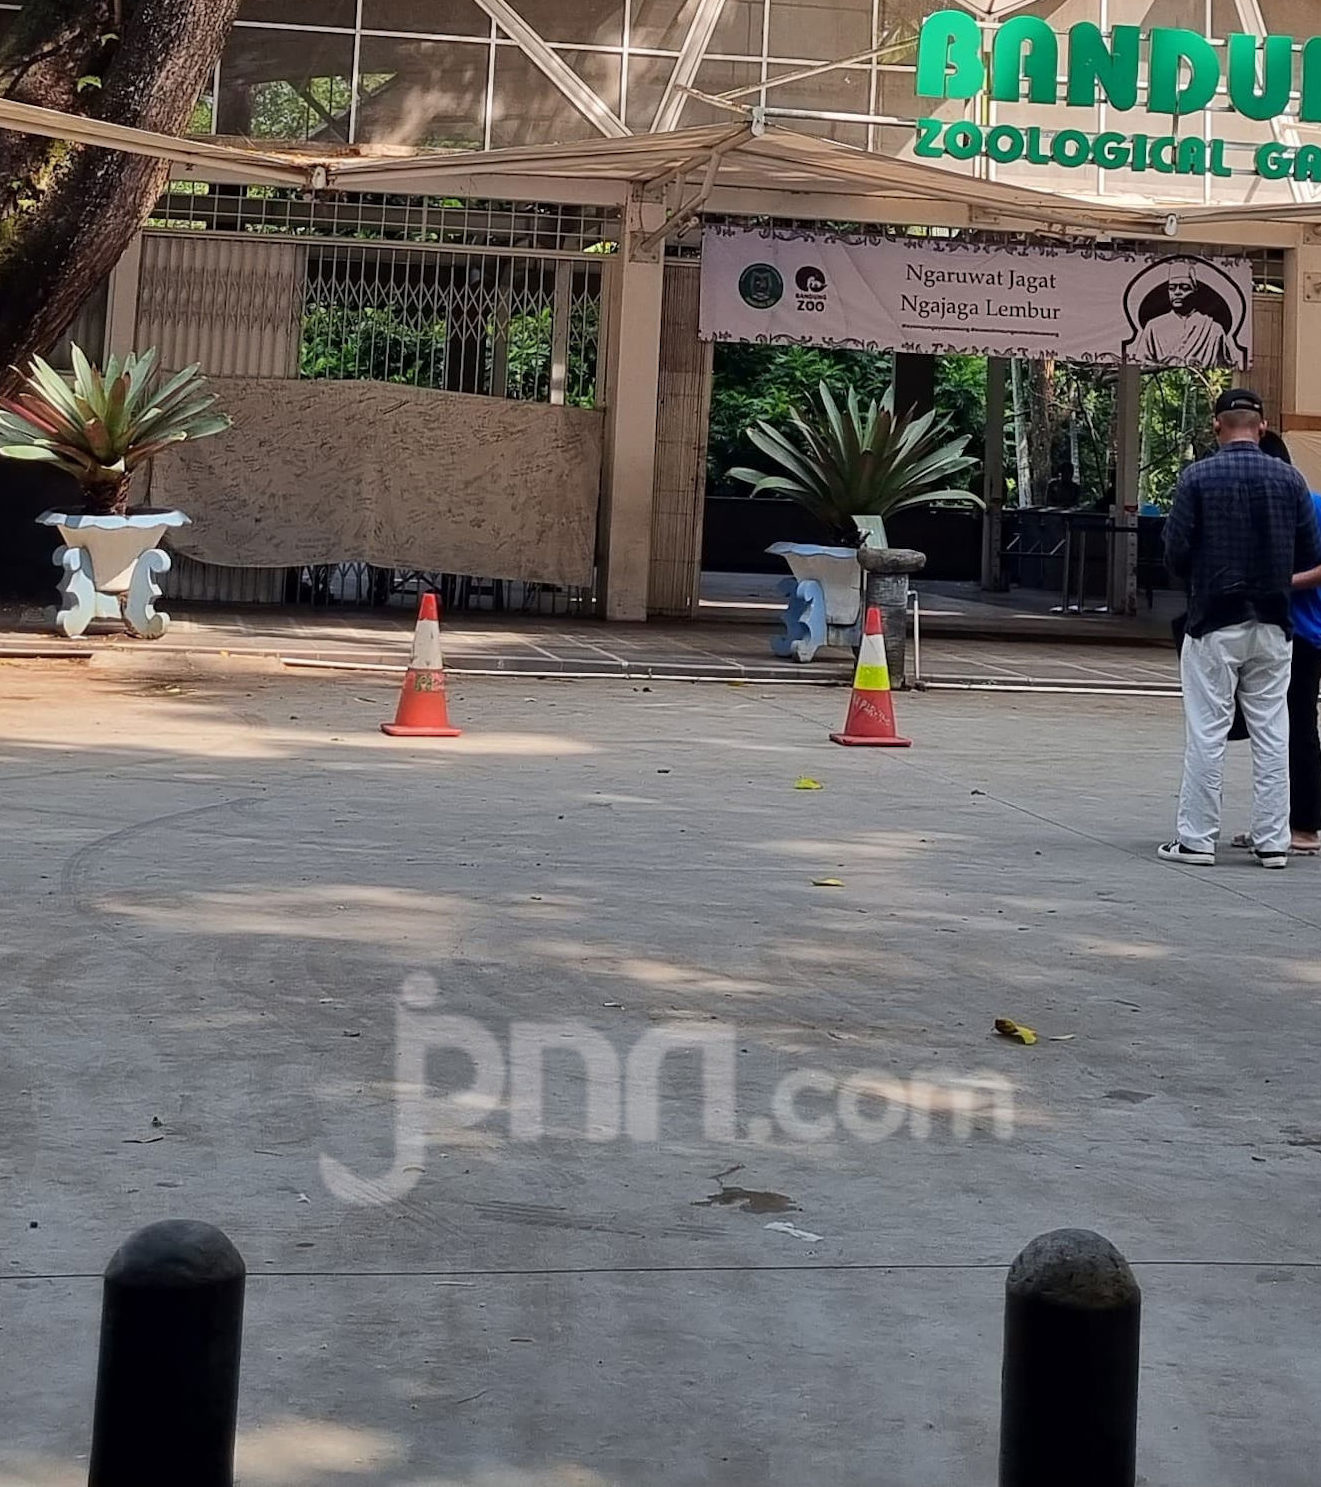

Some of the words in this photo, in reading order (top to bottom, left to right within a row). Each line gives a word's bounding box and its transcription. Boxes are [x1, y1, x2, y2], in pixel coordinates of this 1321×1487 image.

[913, 117, 1232, 177] ZOOLOGICAL
[906, 264, 1004, 288] Ngaruwat
[1008, 270, 1056, 293] Jagat
[797, 300, 825, 312] ZOO
[900, 294, 979, 320] Ngajaga
[986, 299, 1061, 320] Lembur
